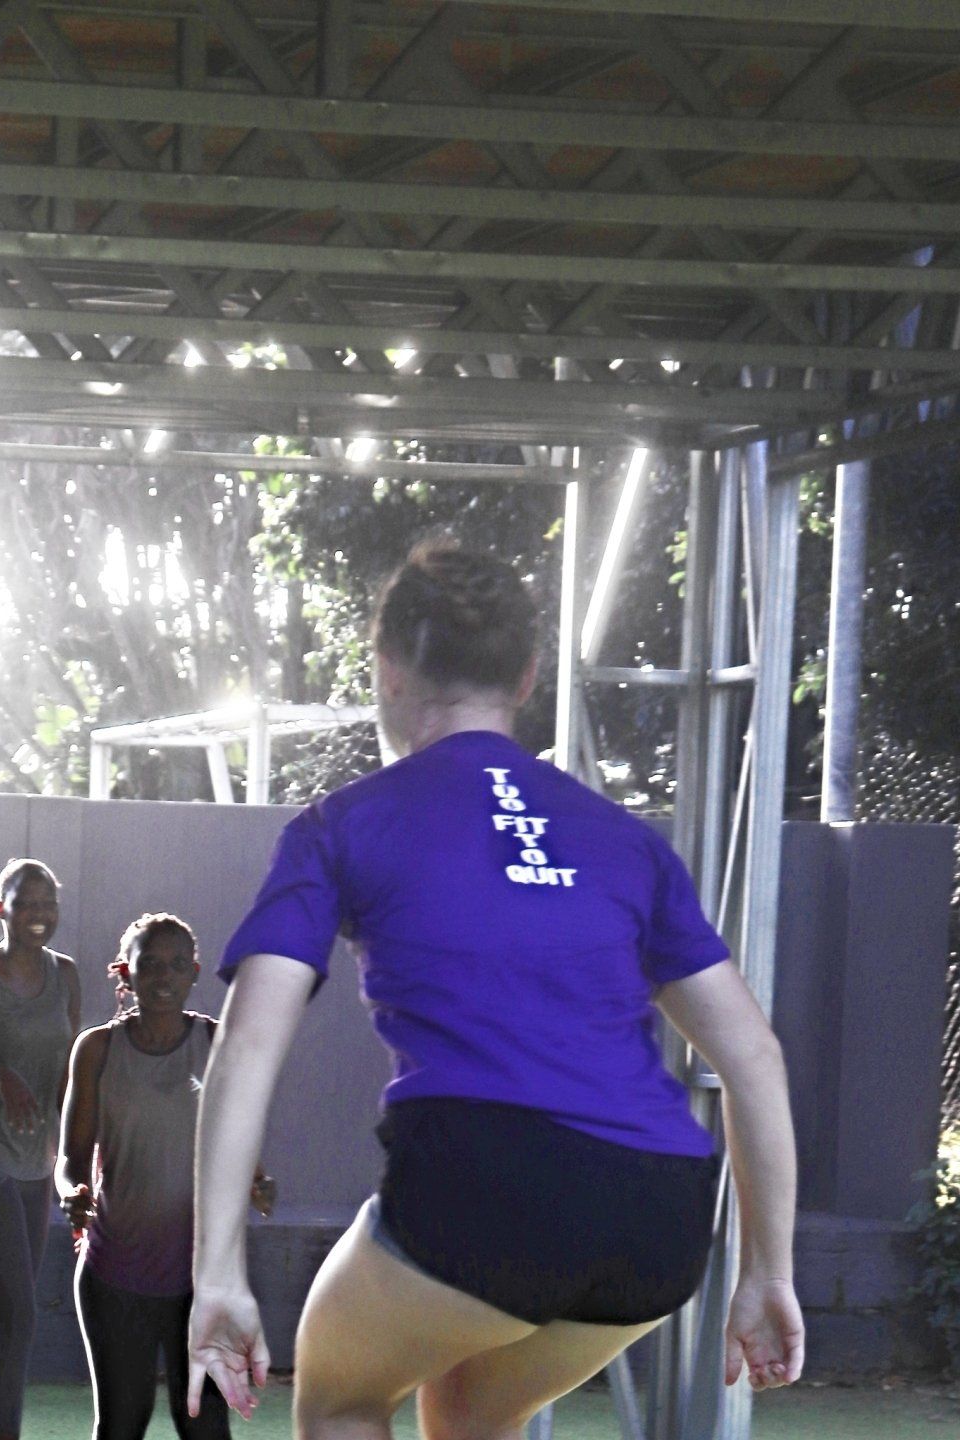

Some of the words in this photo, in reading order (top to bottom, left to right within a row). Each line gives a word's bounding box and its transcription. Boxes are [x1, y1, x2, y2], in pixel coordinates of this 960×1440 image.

[492, 814, 549, 835] FIT
[513, 833, 548, 866] TO
[505, 864, 578, 887] QUIT
